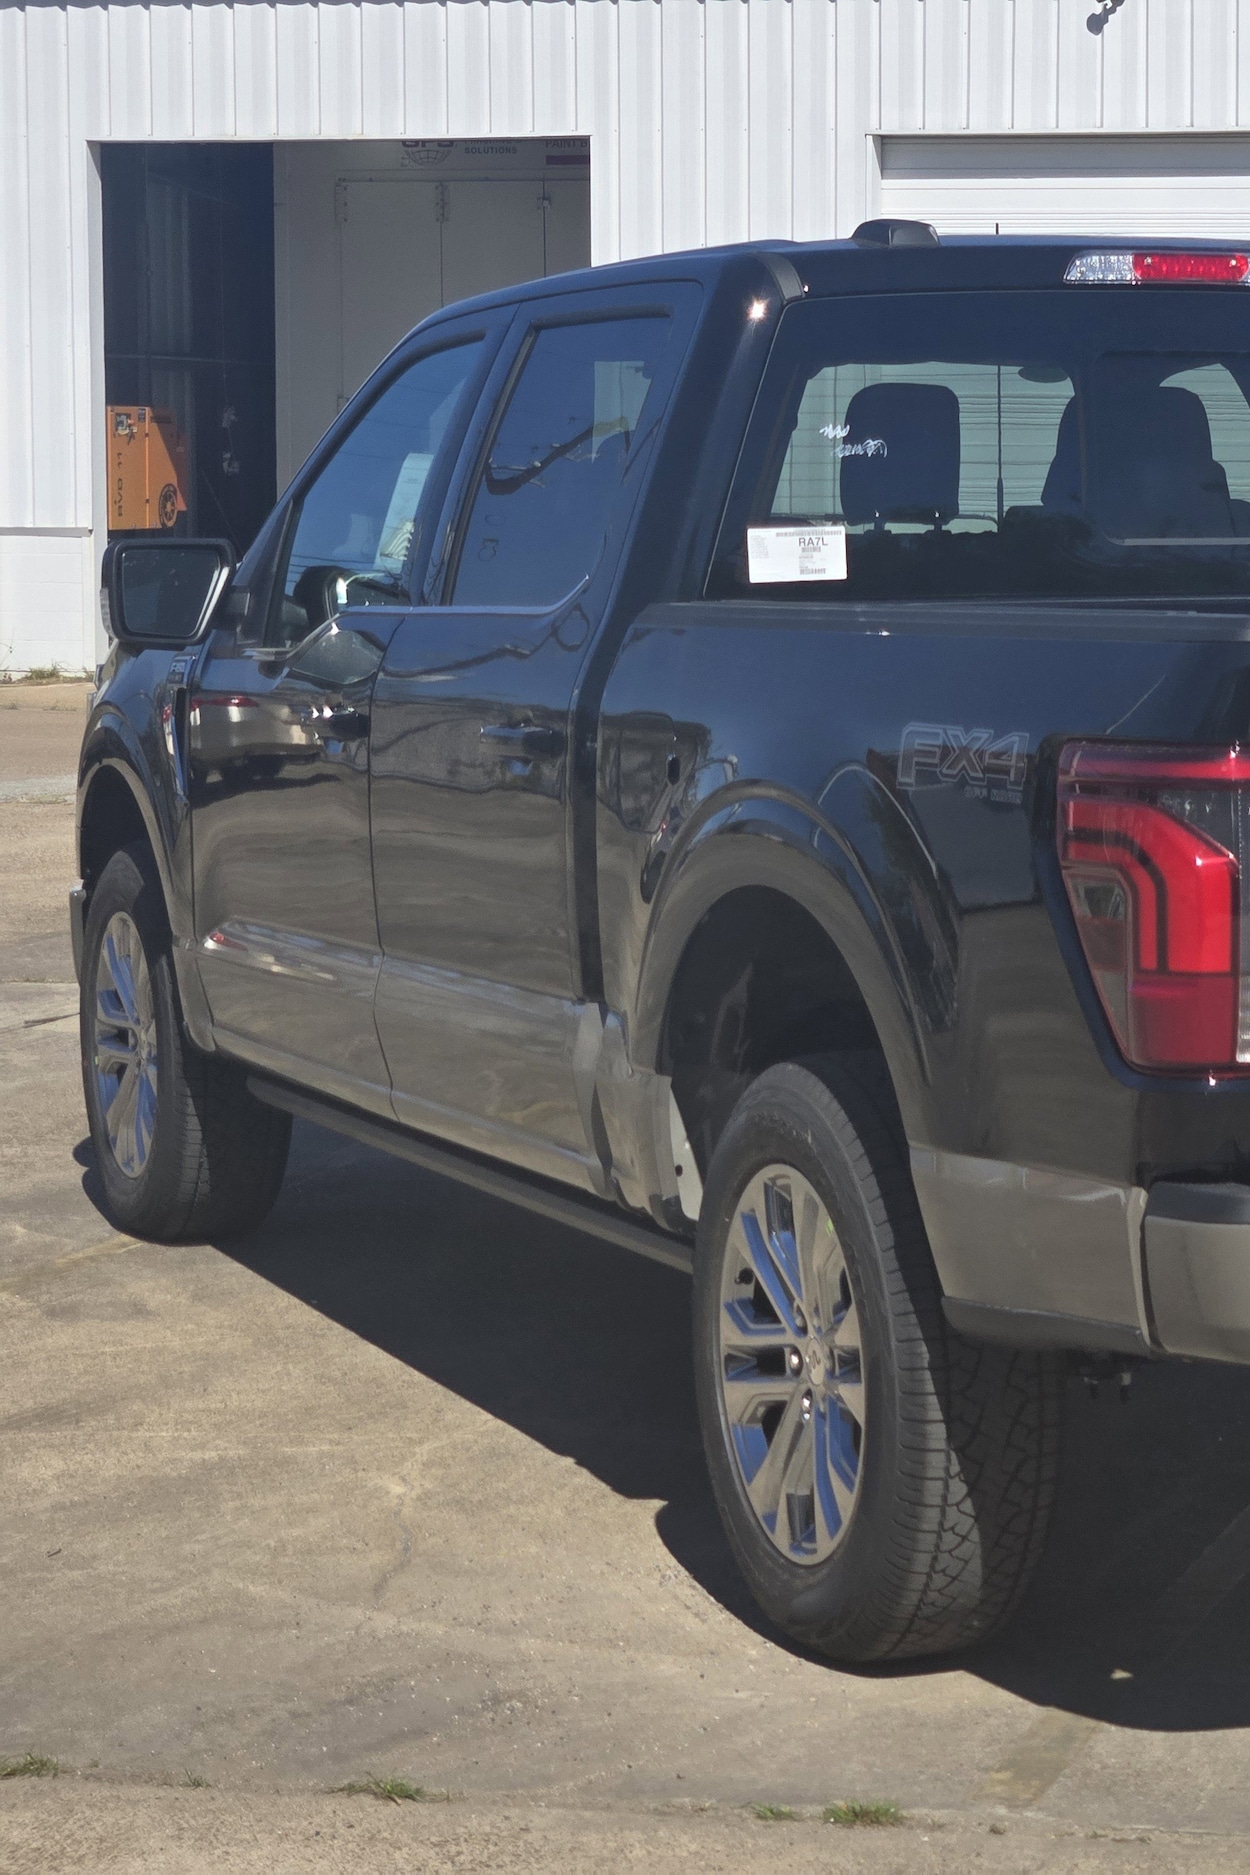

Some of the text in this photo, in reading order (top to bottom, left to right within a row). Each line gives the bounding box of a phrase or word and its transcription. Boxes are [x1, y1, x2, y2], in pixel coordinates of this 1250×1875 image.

[464, 145, 518, 155] SOLUTIONS
[798, 536, 828, 547] RA7L
[897, 721, 1030, 790] FX4
